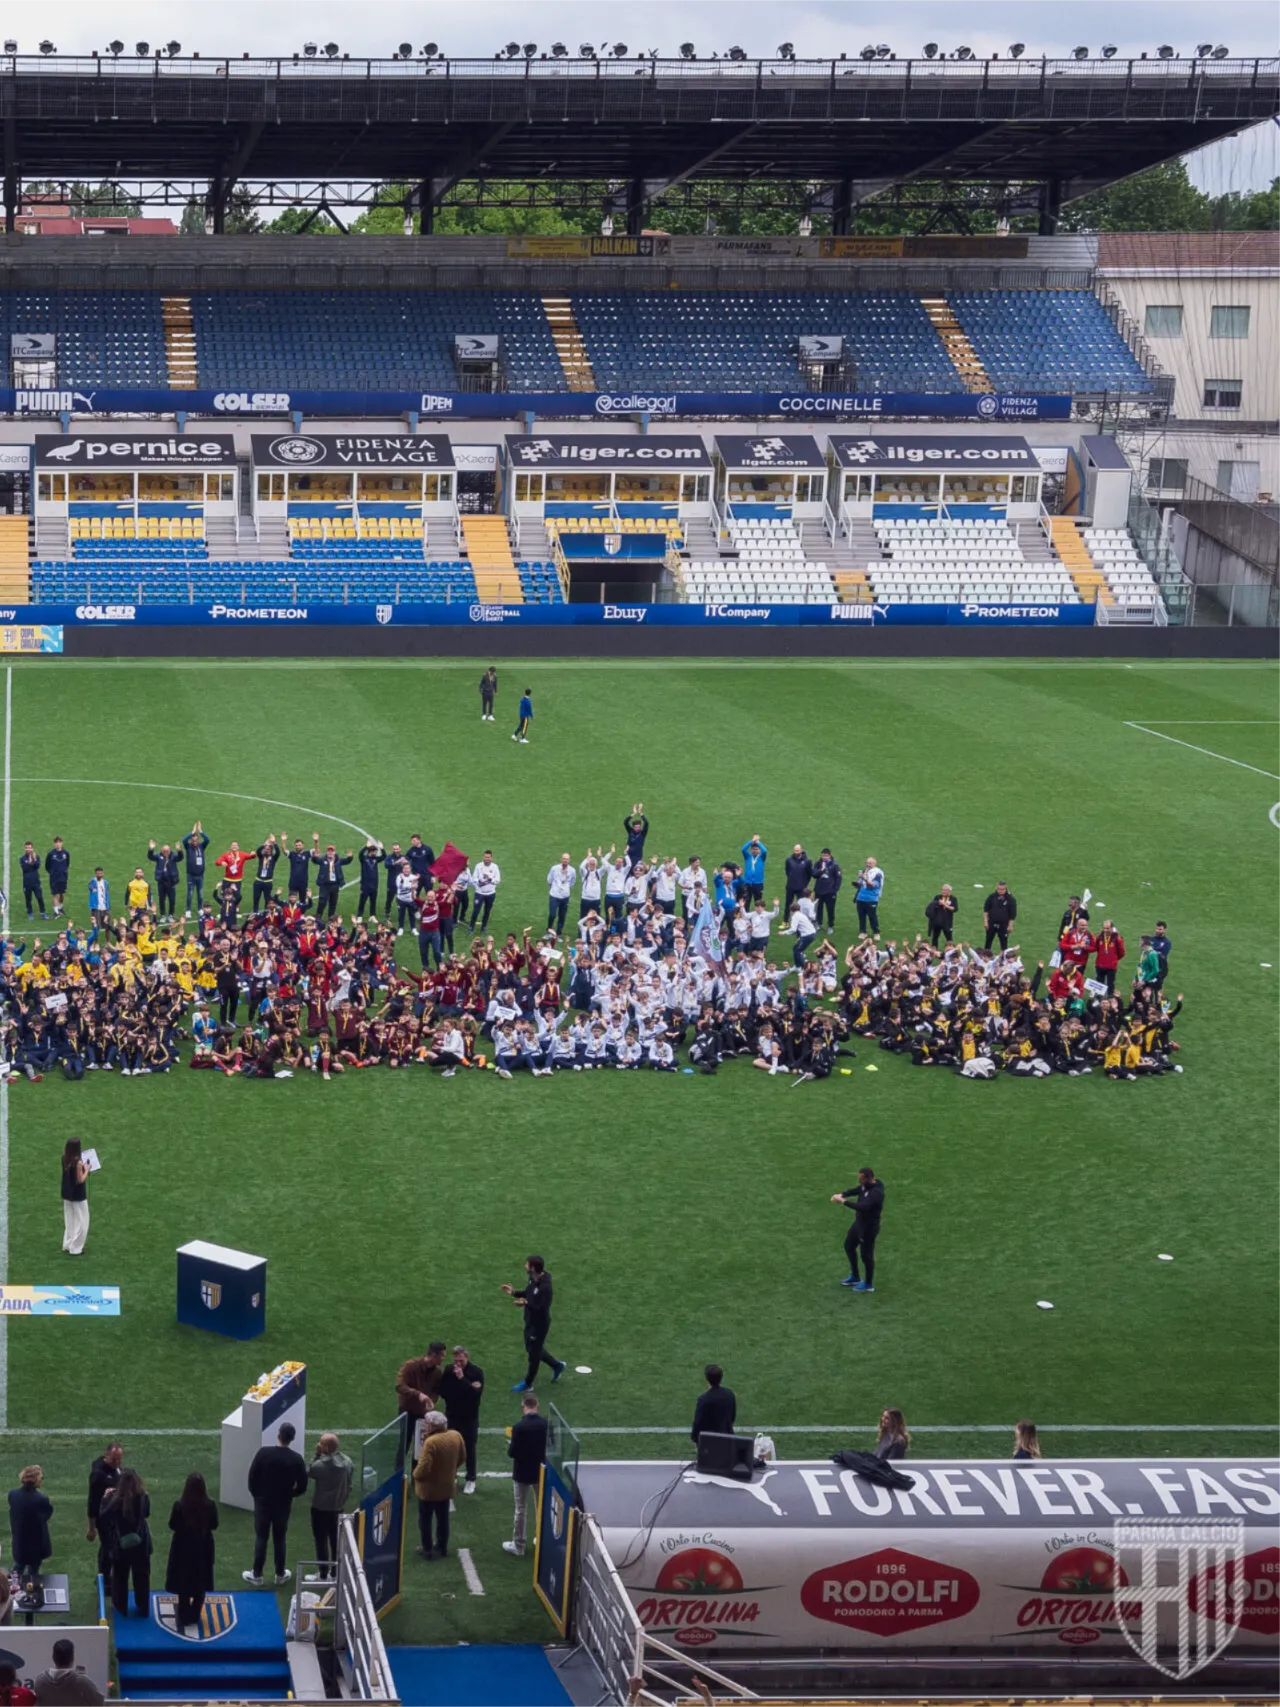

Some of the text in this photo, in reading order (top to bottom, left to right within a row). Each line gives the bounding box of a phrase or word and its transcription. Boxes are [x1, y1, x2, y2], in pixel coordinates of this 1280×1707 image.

[592, 238, 638, 255] BALKAN
[13, 347, 54, 356] ITCompany
[16, 392, 73, 410] PUMA
[213, 393, 290, 411] COLSER
[612, 395, 676, 413] callegari
[779, 398, 882, 411] COCCINELLE
[1002, 398, 1038, 406] FIDENZA
[1002, 407, 1038, 415] VILLAGE
[335, 439, 435, 449] FIDENZA
[337, 452, 439, 462] VILLAGE
[560, 446, 702, 461] ilger.com
[887, 446, 1028, 461] ilger.com
[75, 605, 136, 619] COLSER
[208, 605, 307, 618] PROMETEON
[603, 605, 647, 621] Ebury
[705, 605, 771, 619] ITCompany
[831, 605, 873, 619] PUMA
[960, 605, 1059, 617] PROMETEON
[799, 1468, 1144, 1516] FOREVER.
[692, 1533, 701, 1543] in
[702, 1532, 735, 1554] Cucina
[1076, 1533, 1085, 1542] in
[876, 1564, 907, 1576] 1896
[1260, 1563, 1280, 1573] 189
[822, 1579, 960, 1603] RODOLFI
[636, 1598, 761, 1626] ORTOLINA
[834, 1607, 944, 1617] POMODORO A PARMA
[1017, 1598, 1143, 1627] ORTOLINA
